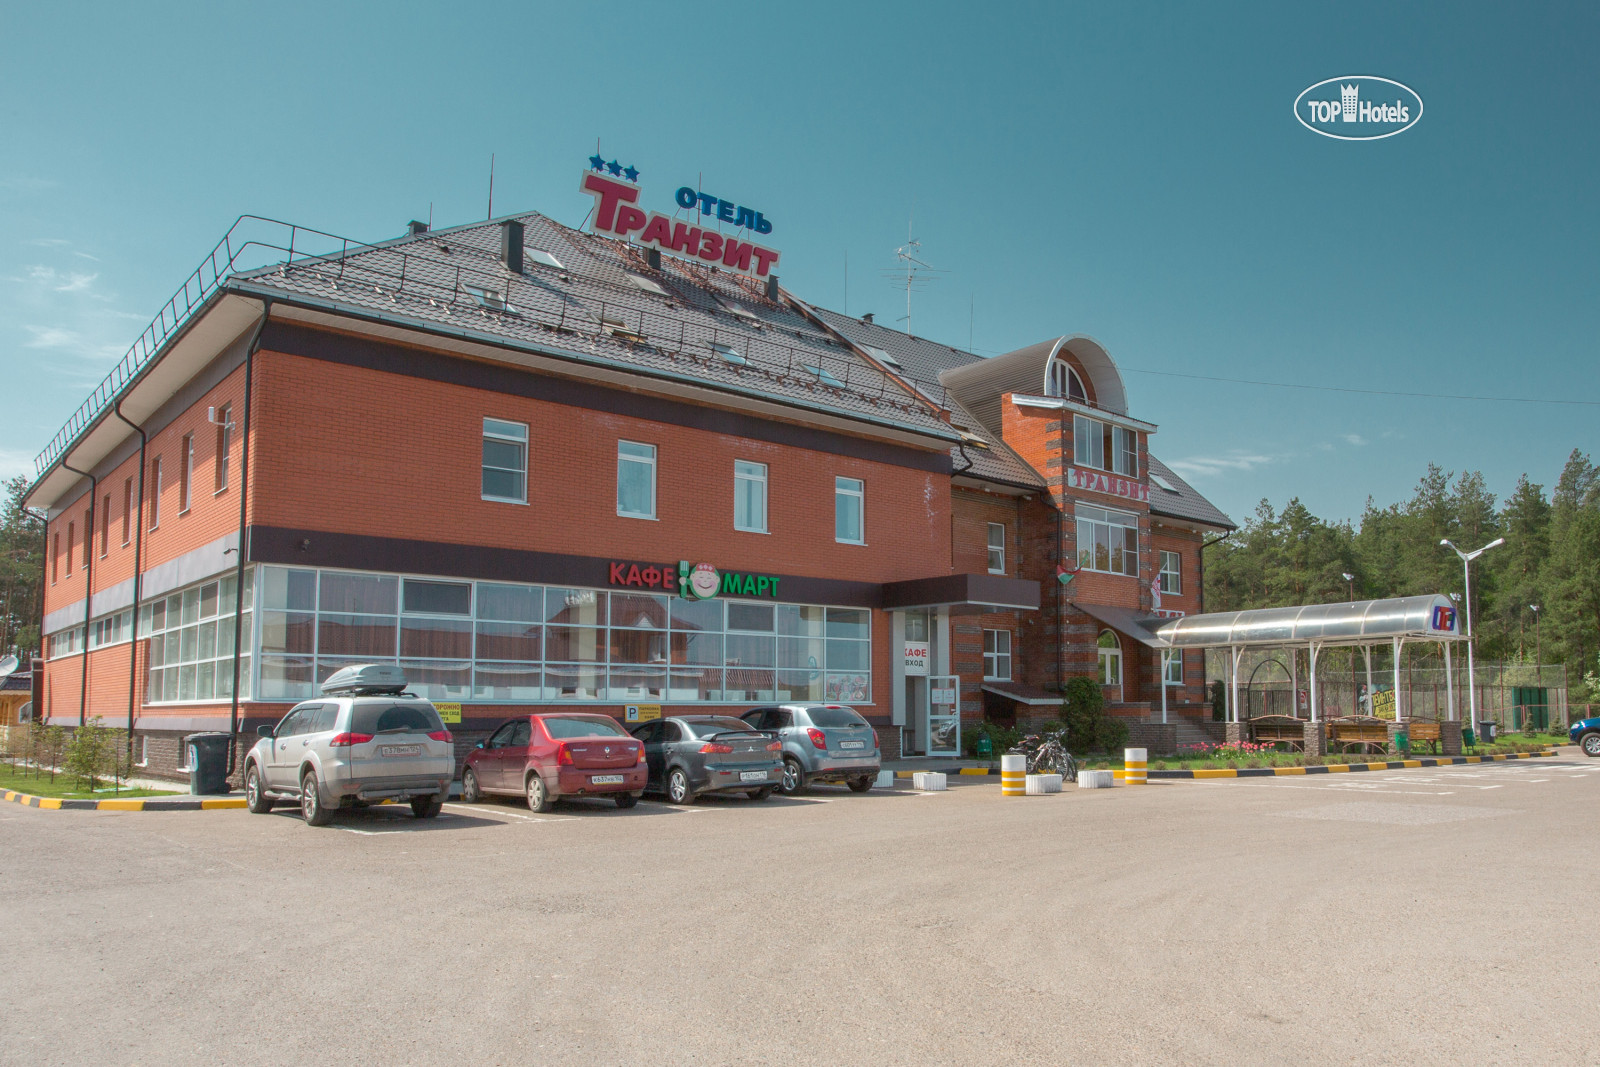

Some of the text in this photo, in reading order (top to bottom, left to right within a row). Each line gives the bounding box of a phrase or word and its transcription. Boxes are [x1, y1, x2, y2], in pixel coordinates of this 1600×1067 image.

[584, 174, 779, 277] ТРАНЗИТ
[675, 186, 773, 235] ОТЕЛЬ
[1073, 469, 1150, 501] ТРАНЗИТ
[609, 562, 674, 589] КАФЕ
[905, 659, 923, 667] ВХОД
